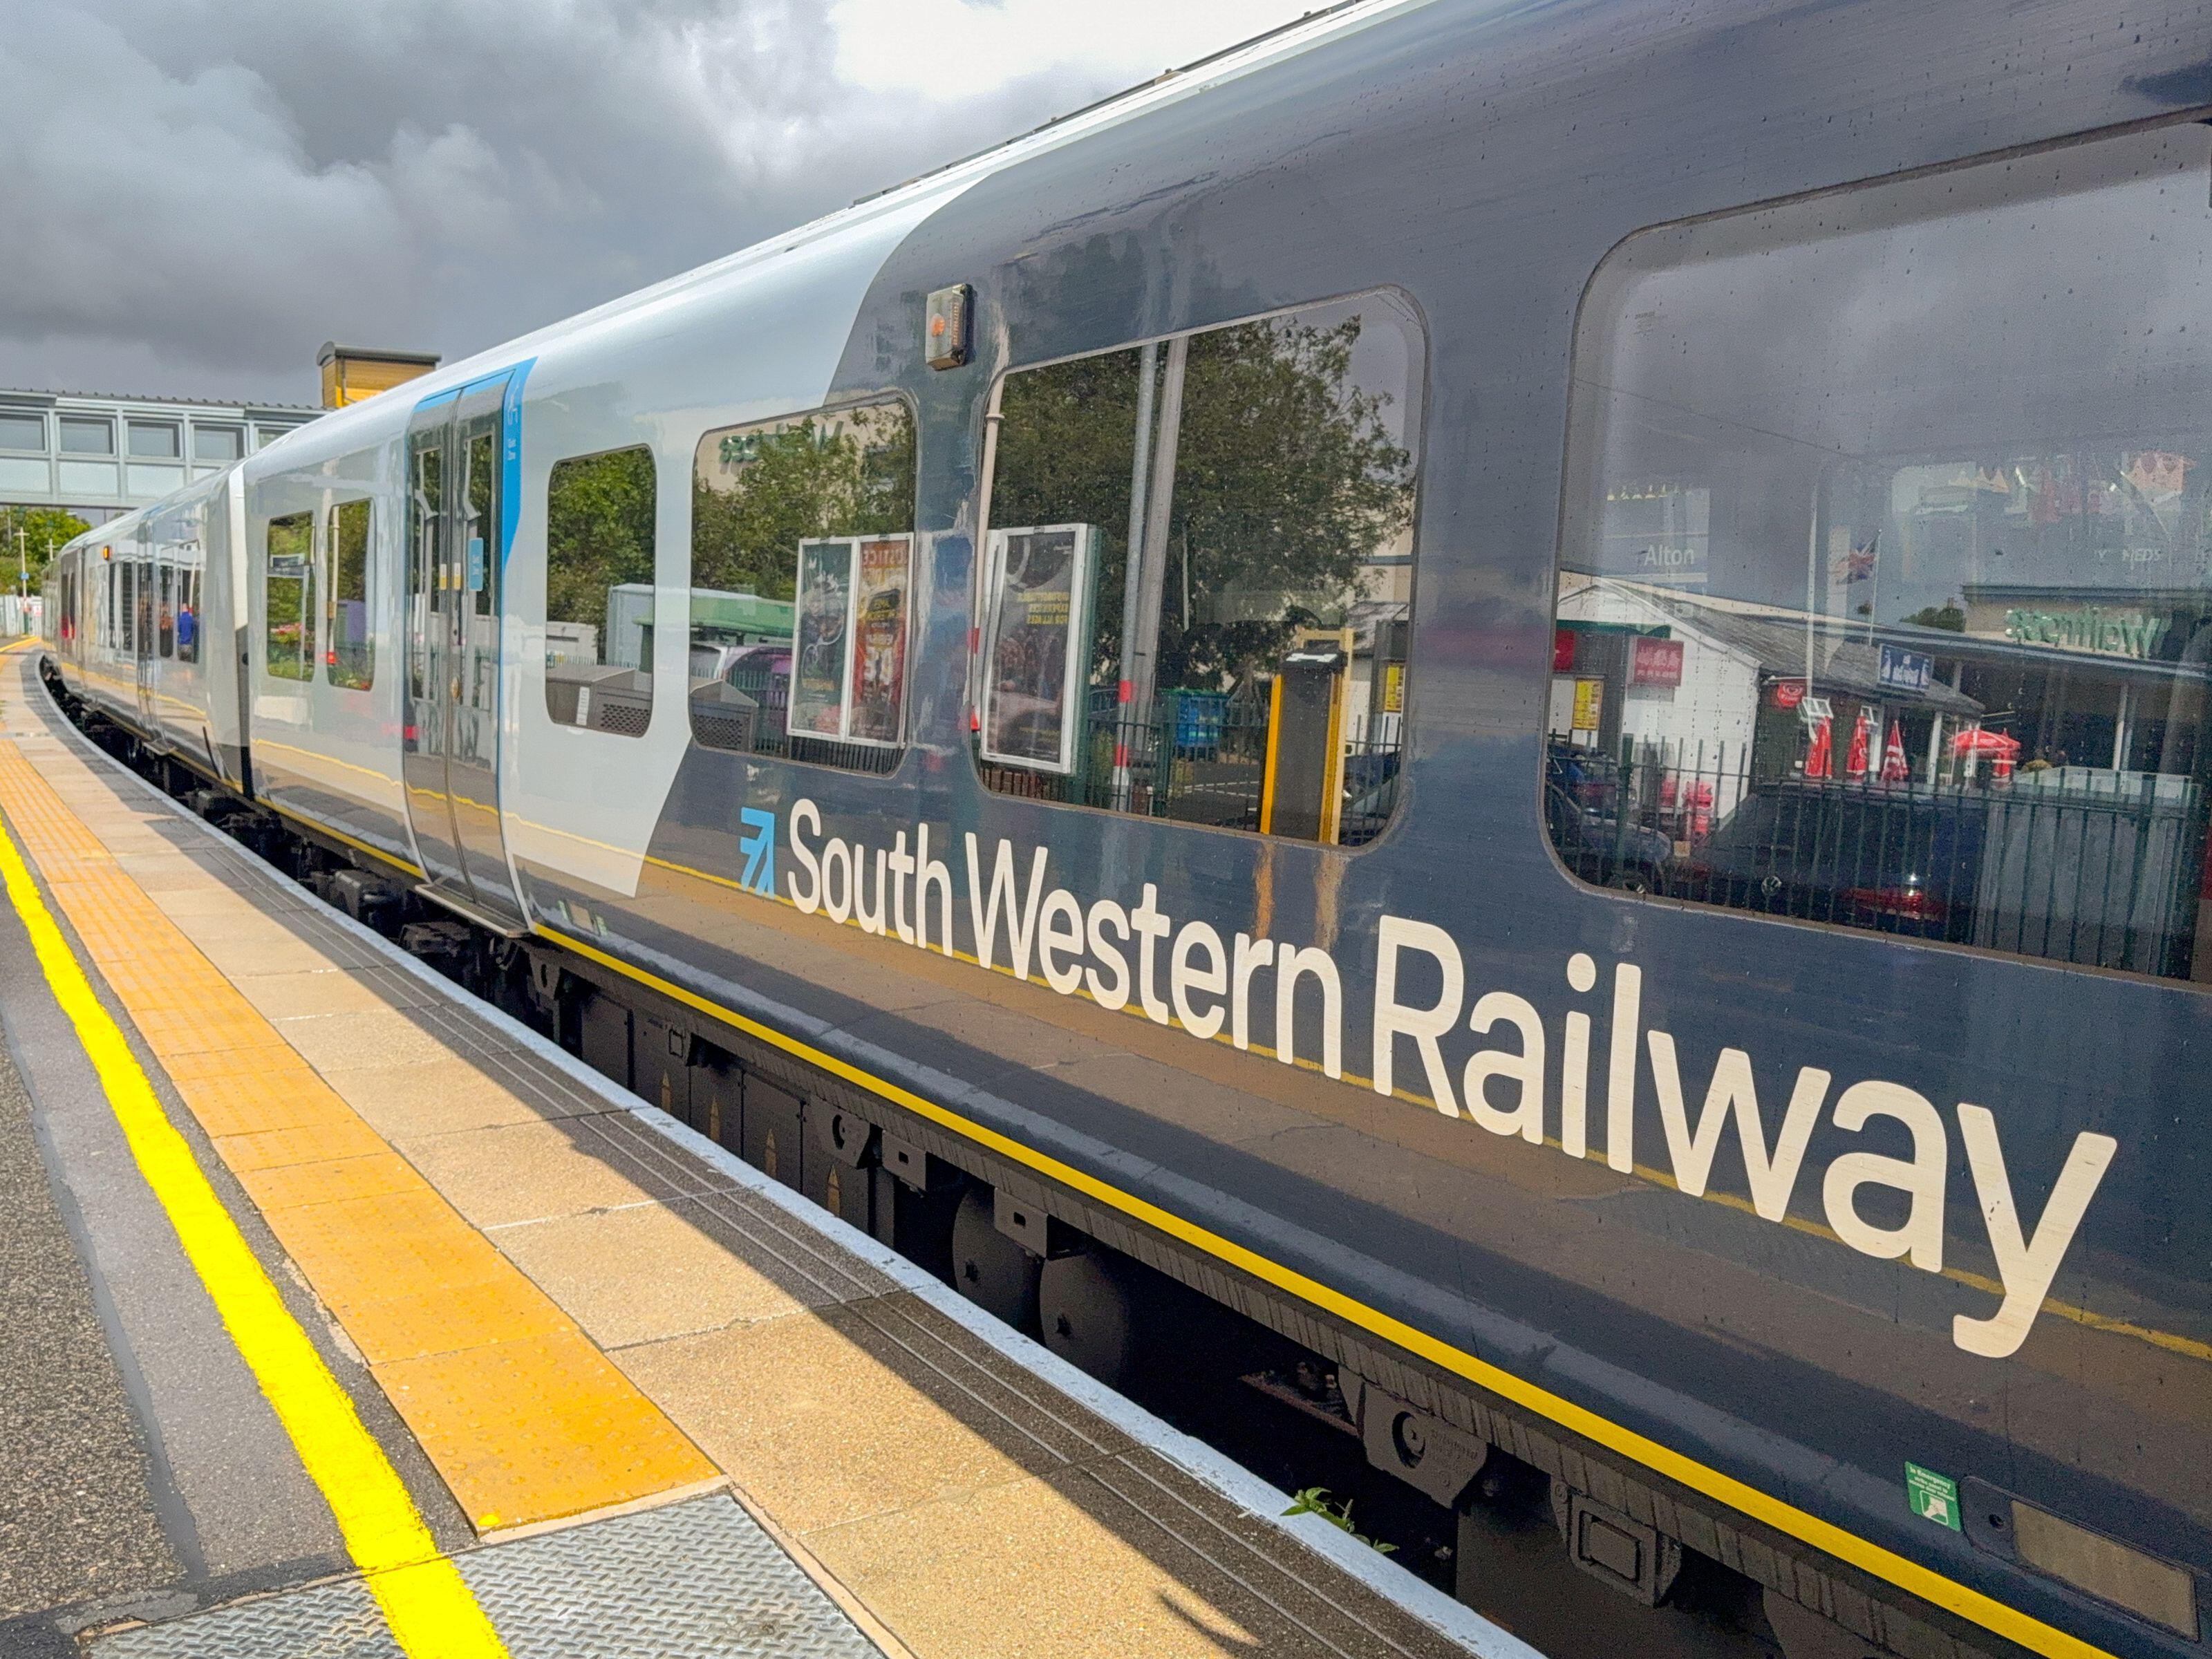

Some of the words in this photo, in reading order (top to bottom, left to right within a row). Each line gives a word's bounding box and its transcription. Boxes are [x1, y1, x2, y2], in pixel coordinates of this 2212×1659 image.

[1644, 544, 1694, 567] Alton
[787, 798, 953, 957] South
[966, 832, 1341, 1079] Western
[1373, 915, 2117, 1358] Railway
